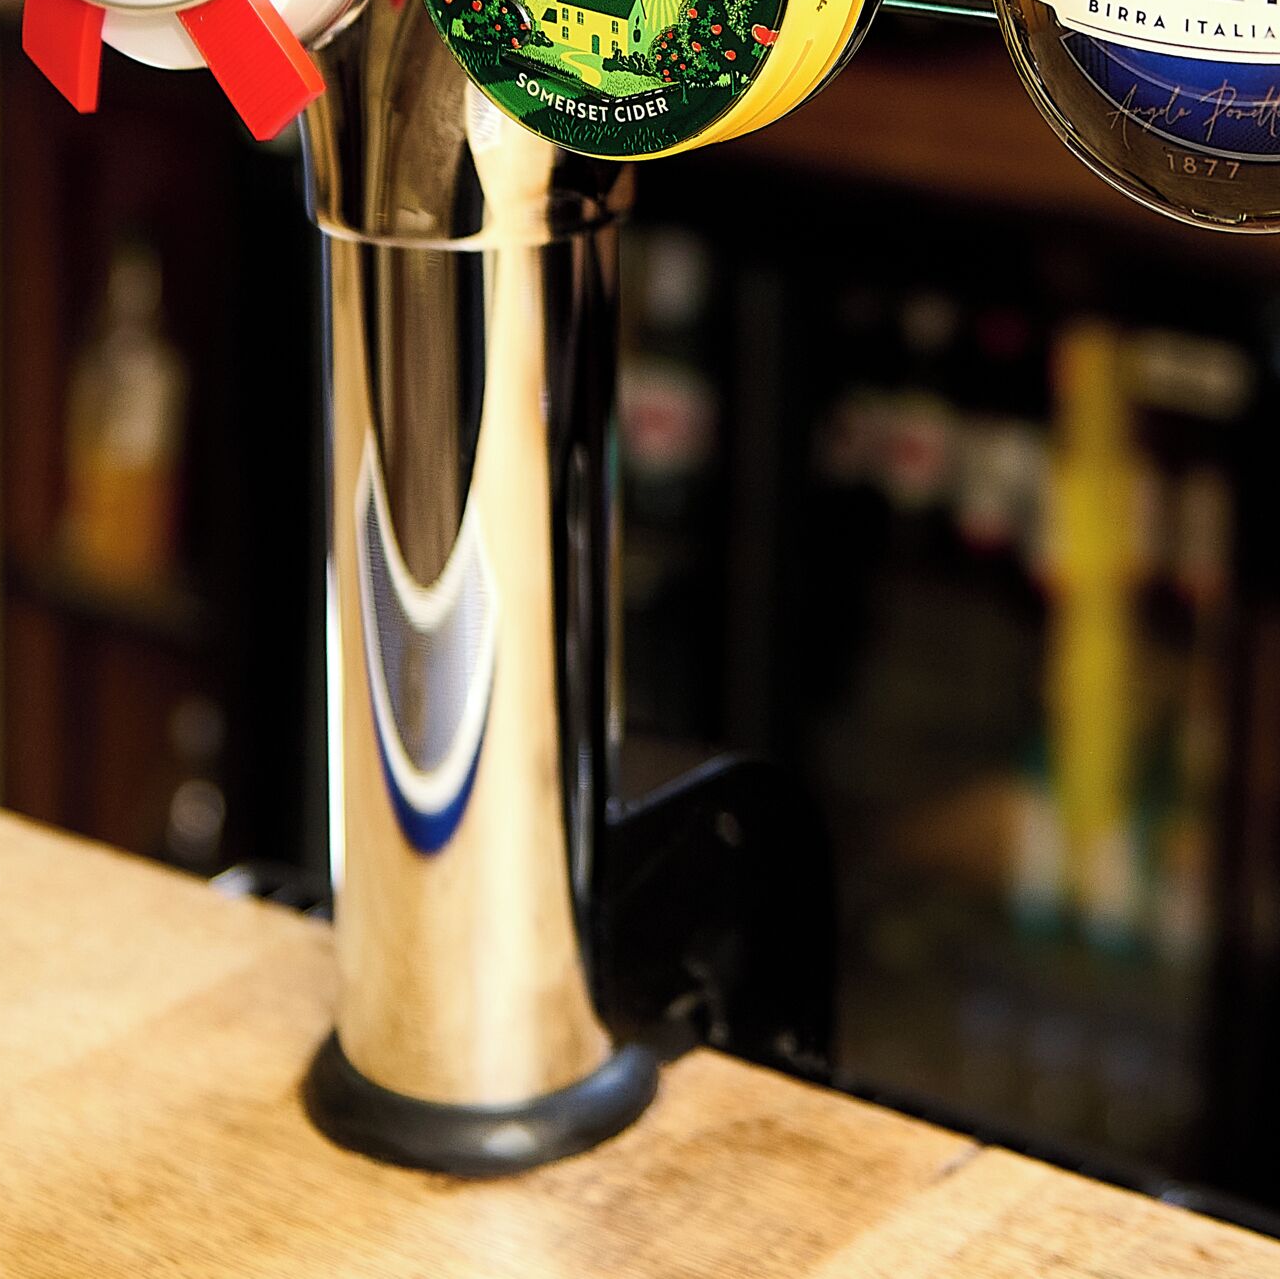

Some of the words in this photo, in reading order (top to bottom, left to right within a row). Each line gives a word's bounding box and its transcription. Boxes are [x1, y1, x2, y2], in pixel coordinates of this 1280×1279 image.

[515, 72, 608, 122] SOMERSET
[614, 97, 669, 122] CIDER
[1167, 154, 1241, 181] 1877
